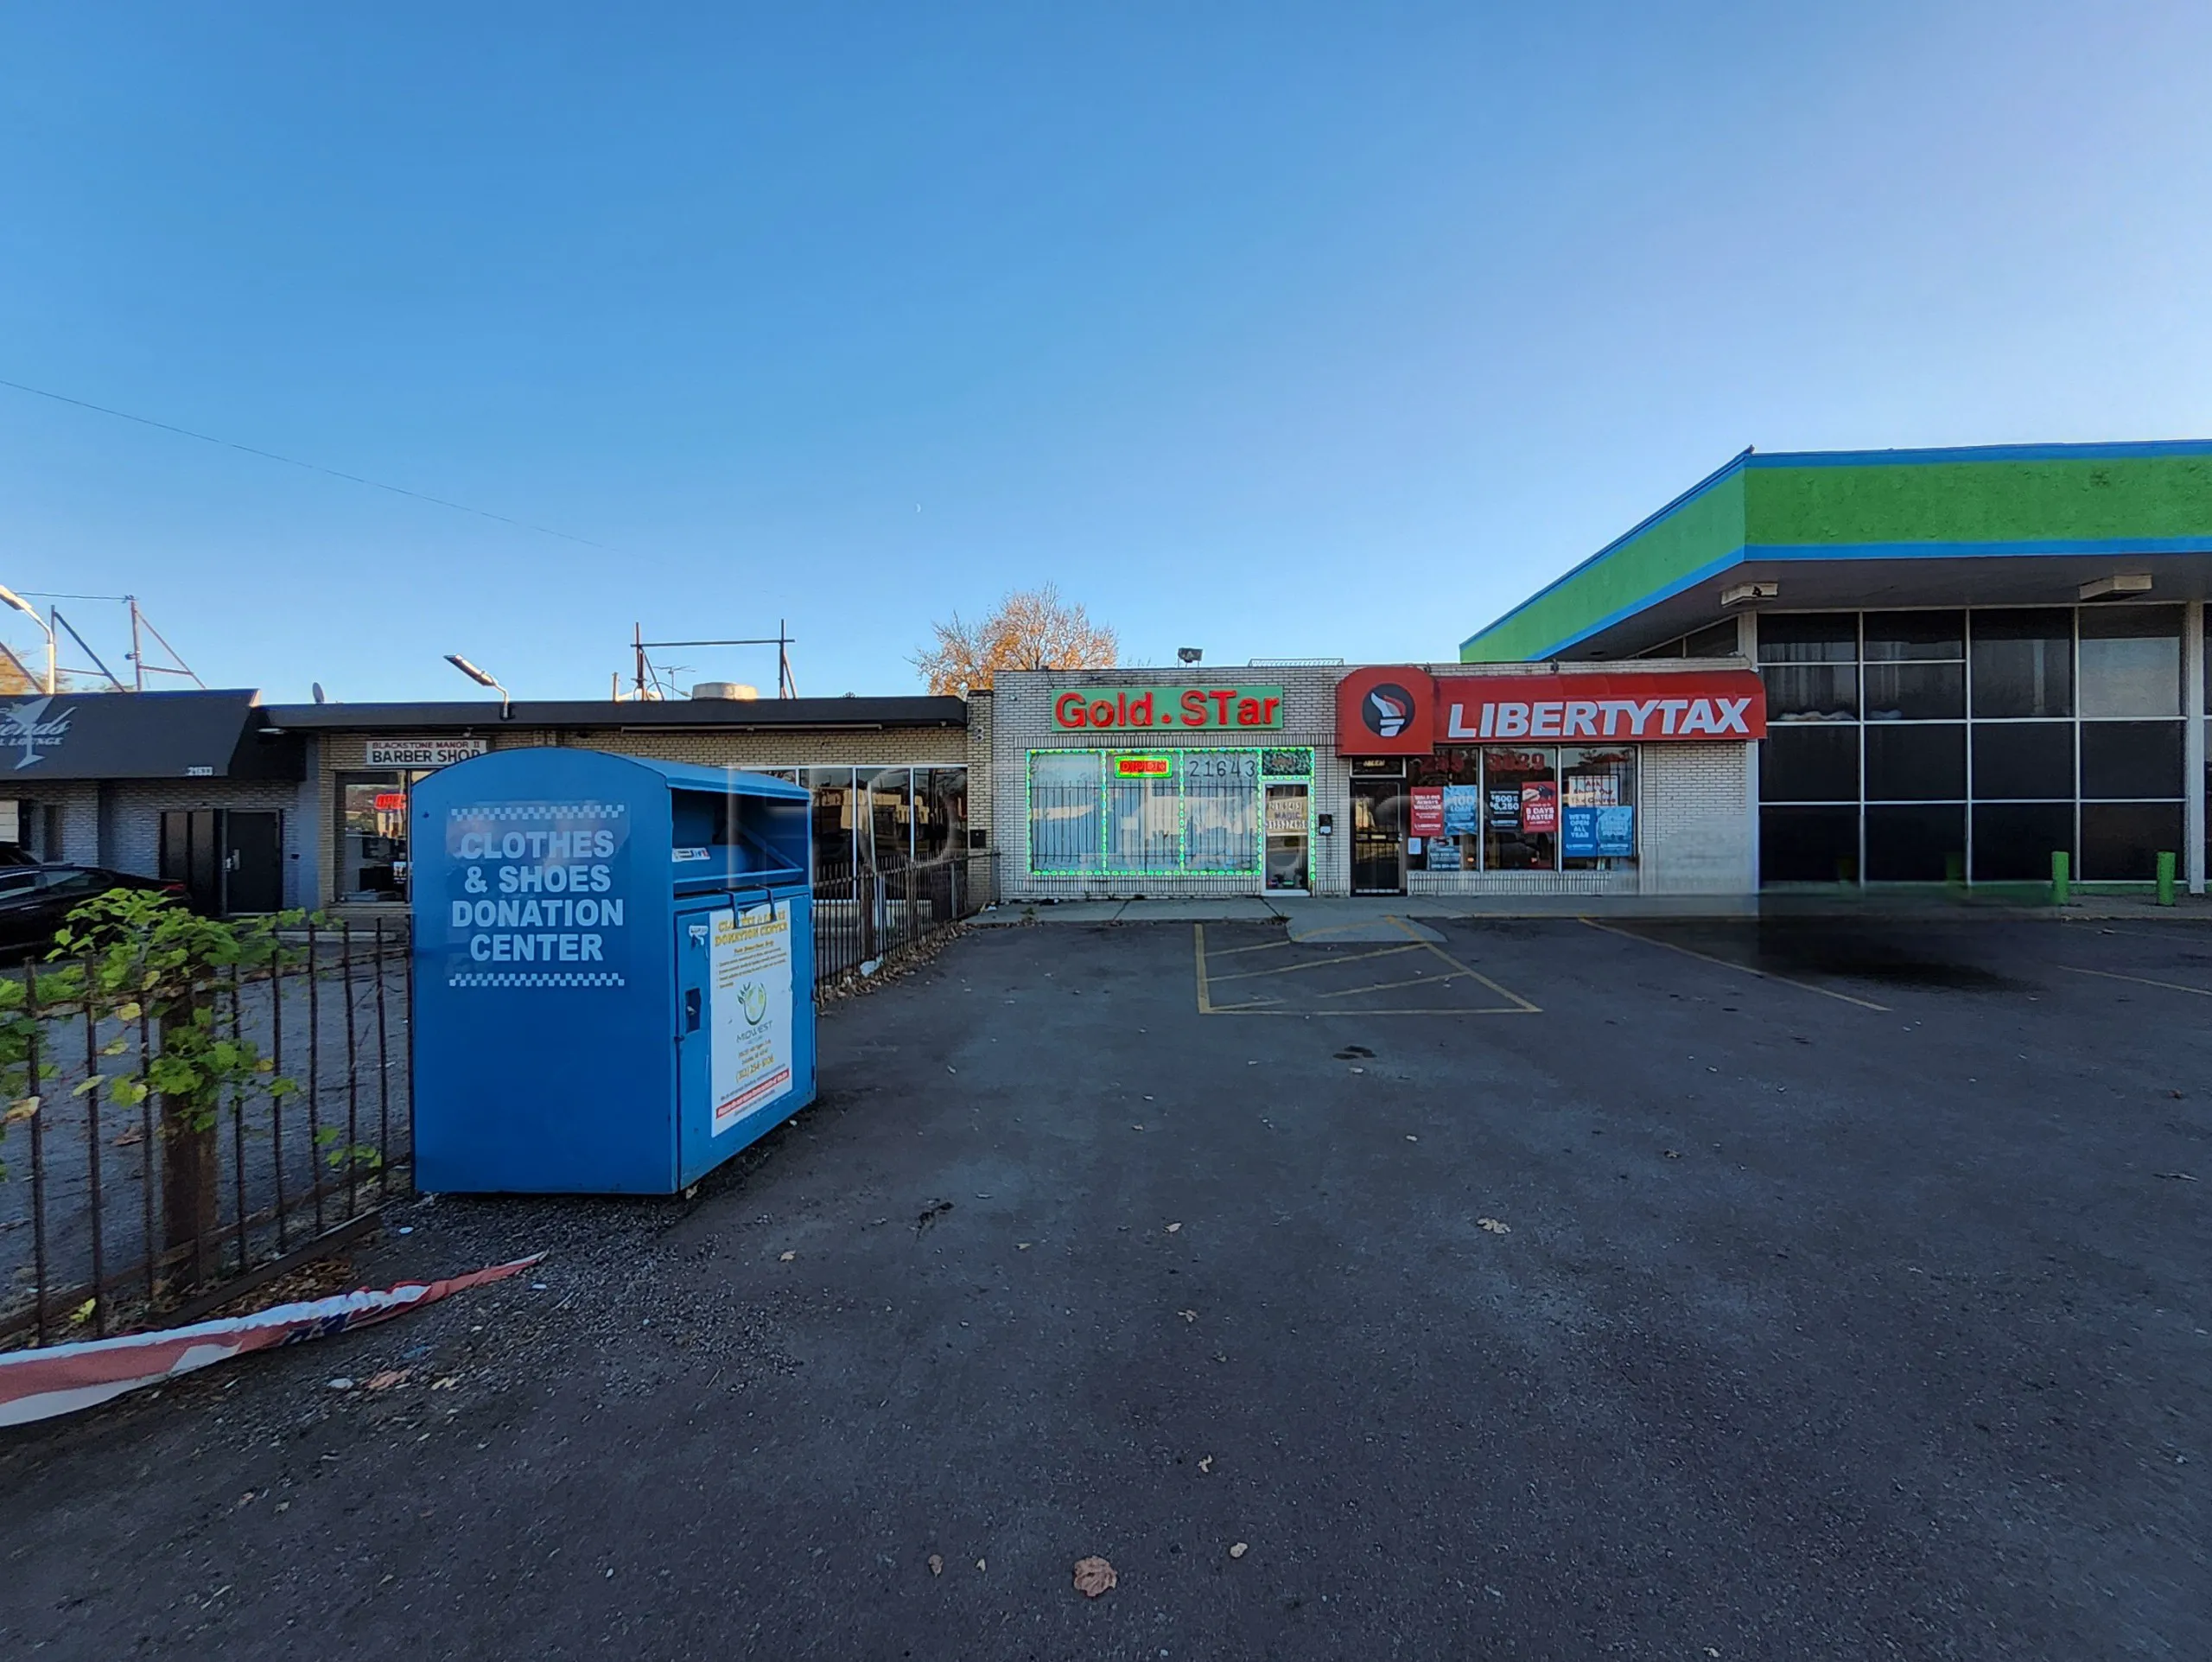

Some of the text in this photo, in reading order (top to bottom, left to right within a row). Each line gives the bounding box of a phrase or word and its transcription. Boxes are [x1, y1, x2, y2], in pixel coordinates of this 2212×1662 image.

[372, 750, 432, 762] BARBER
[1120, 760, 1167, 774] OPEN
[1189, 761, 1255, 777] 21643
[461, 831, 614, 859] CLOTHES
[464, 865, 611, 893] & SHOES
[452, 899, 624, 927] DONATION
[470, 933, 604, 961] CENTER
